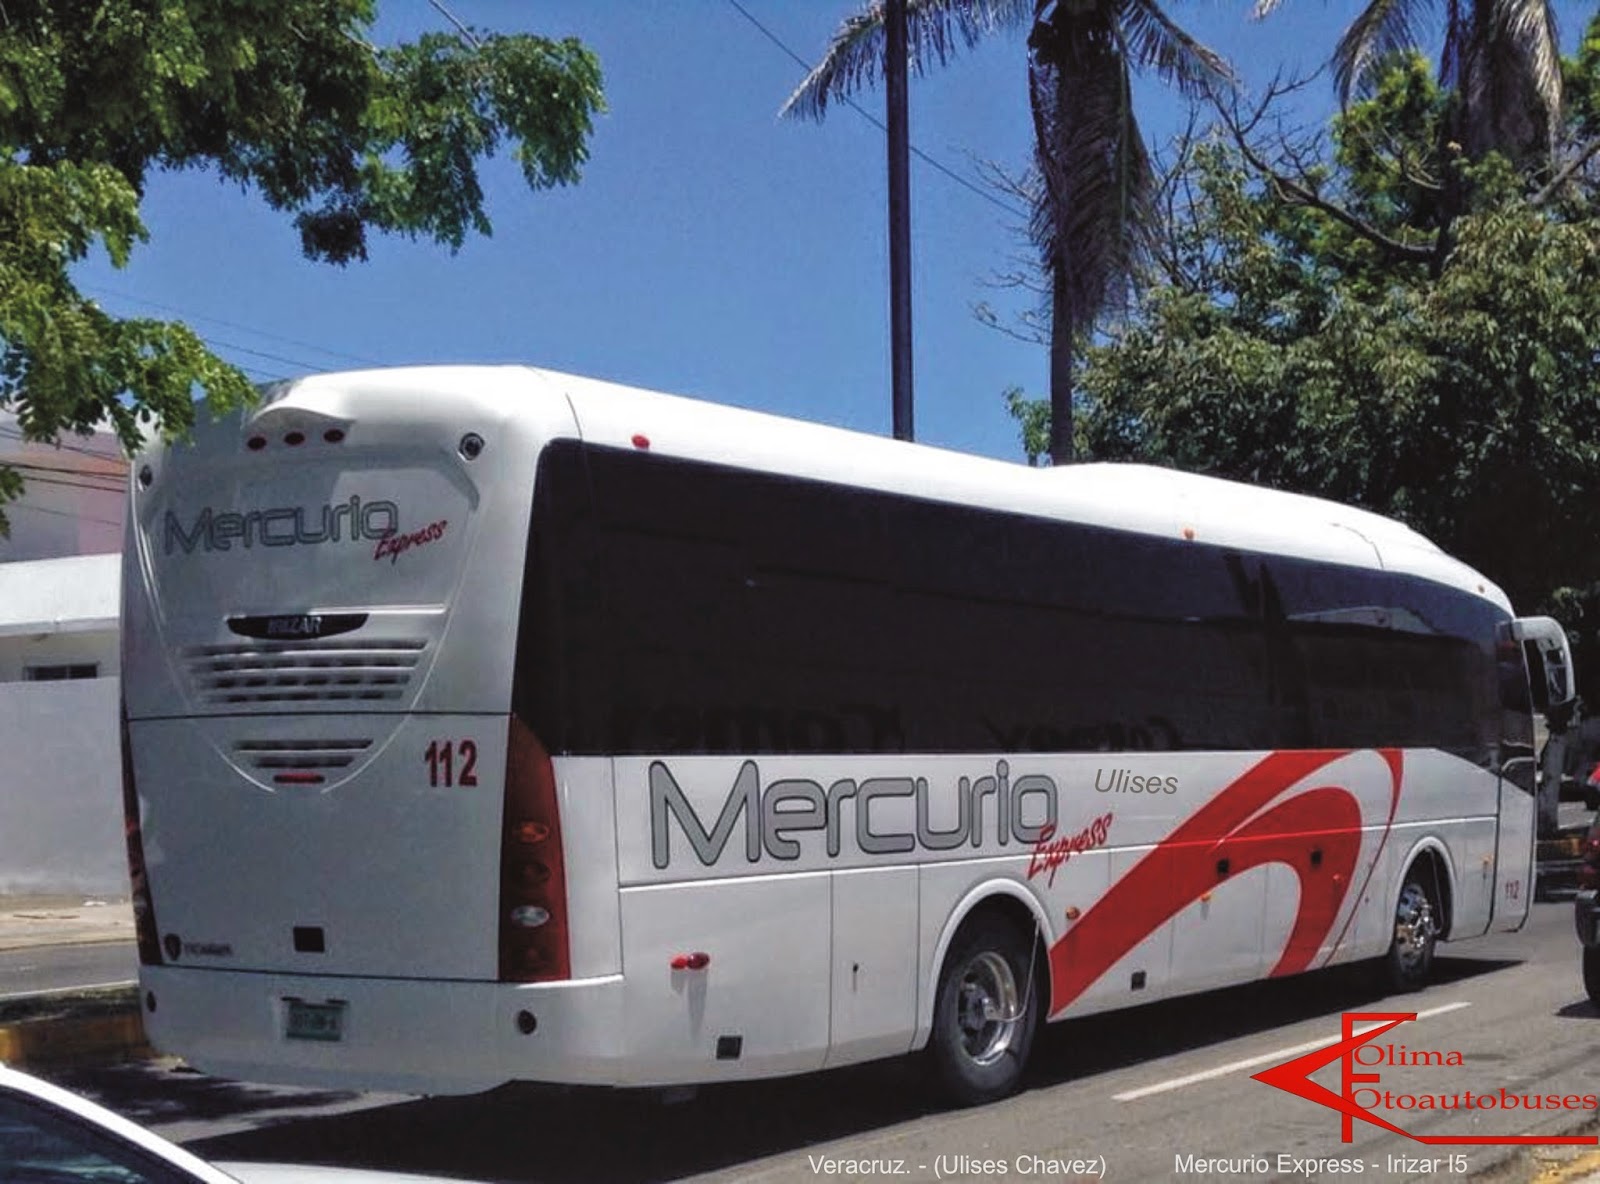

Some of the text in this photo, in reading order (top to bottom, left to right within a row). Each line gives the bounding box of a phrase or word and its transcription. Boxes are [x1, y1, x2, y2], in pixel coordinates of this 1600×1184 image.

[164, 494, 399, 556] Mercurio
[374, 520, 448, 565] Express
[424, 739, 478, 788] 112
[649, 758, 1058, 869] Mercurio
[1028, 811, 1113, 888] Express
